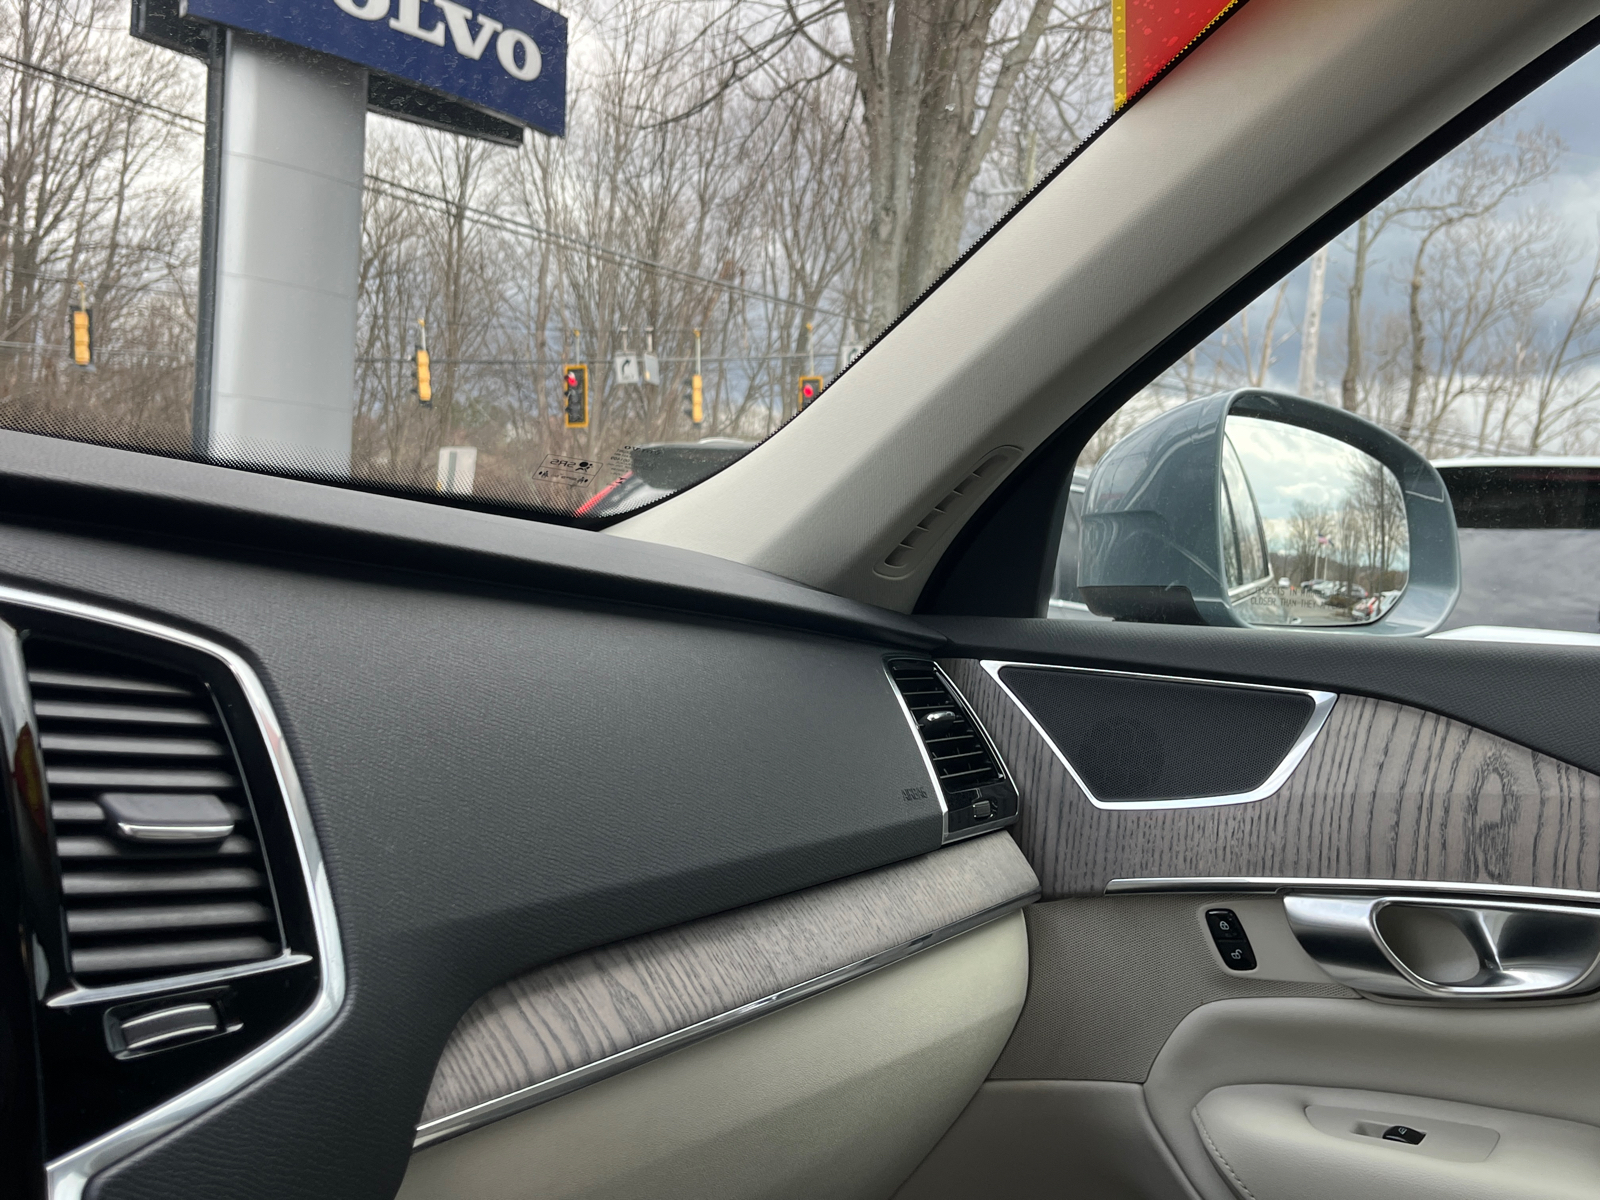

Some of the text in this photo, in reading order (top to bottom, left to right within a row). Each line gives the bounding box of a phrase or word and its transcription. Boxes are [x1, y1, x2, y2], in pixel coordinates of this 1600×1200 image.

[1289, 588, 1298, 597] IN
[1250, 596, 1276, 606] CLOSER
[1280, 598, 1297, 607] THAN
[1301, 599, 1317, 609] THEY
